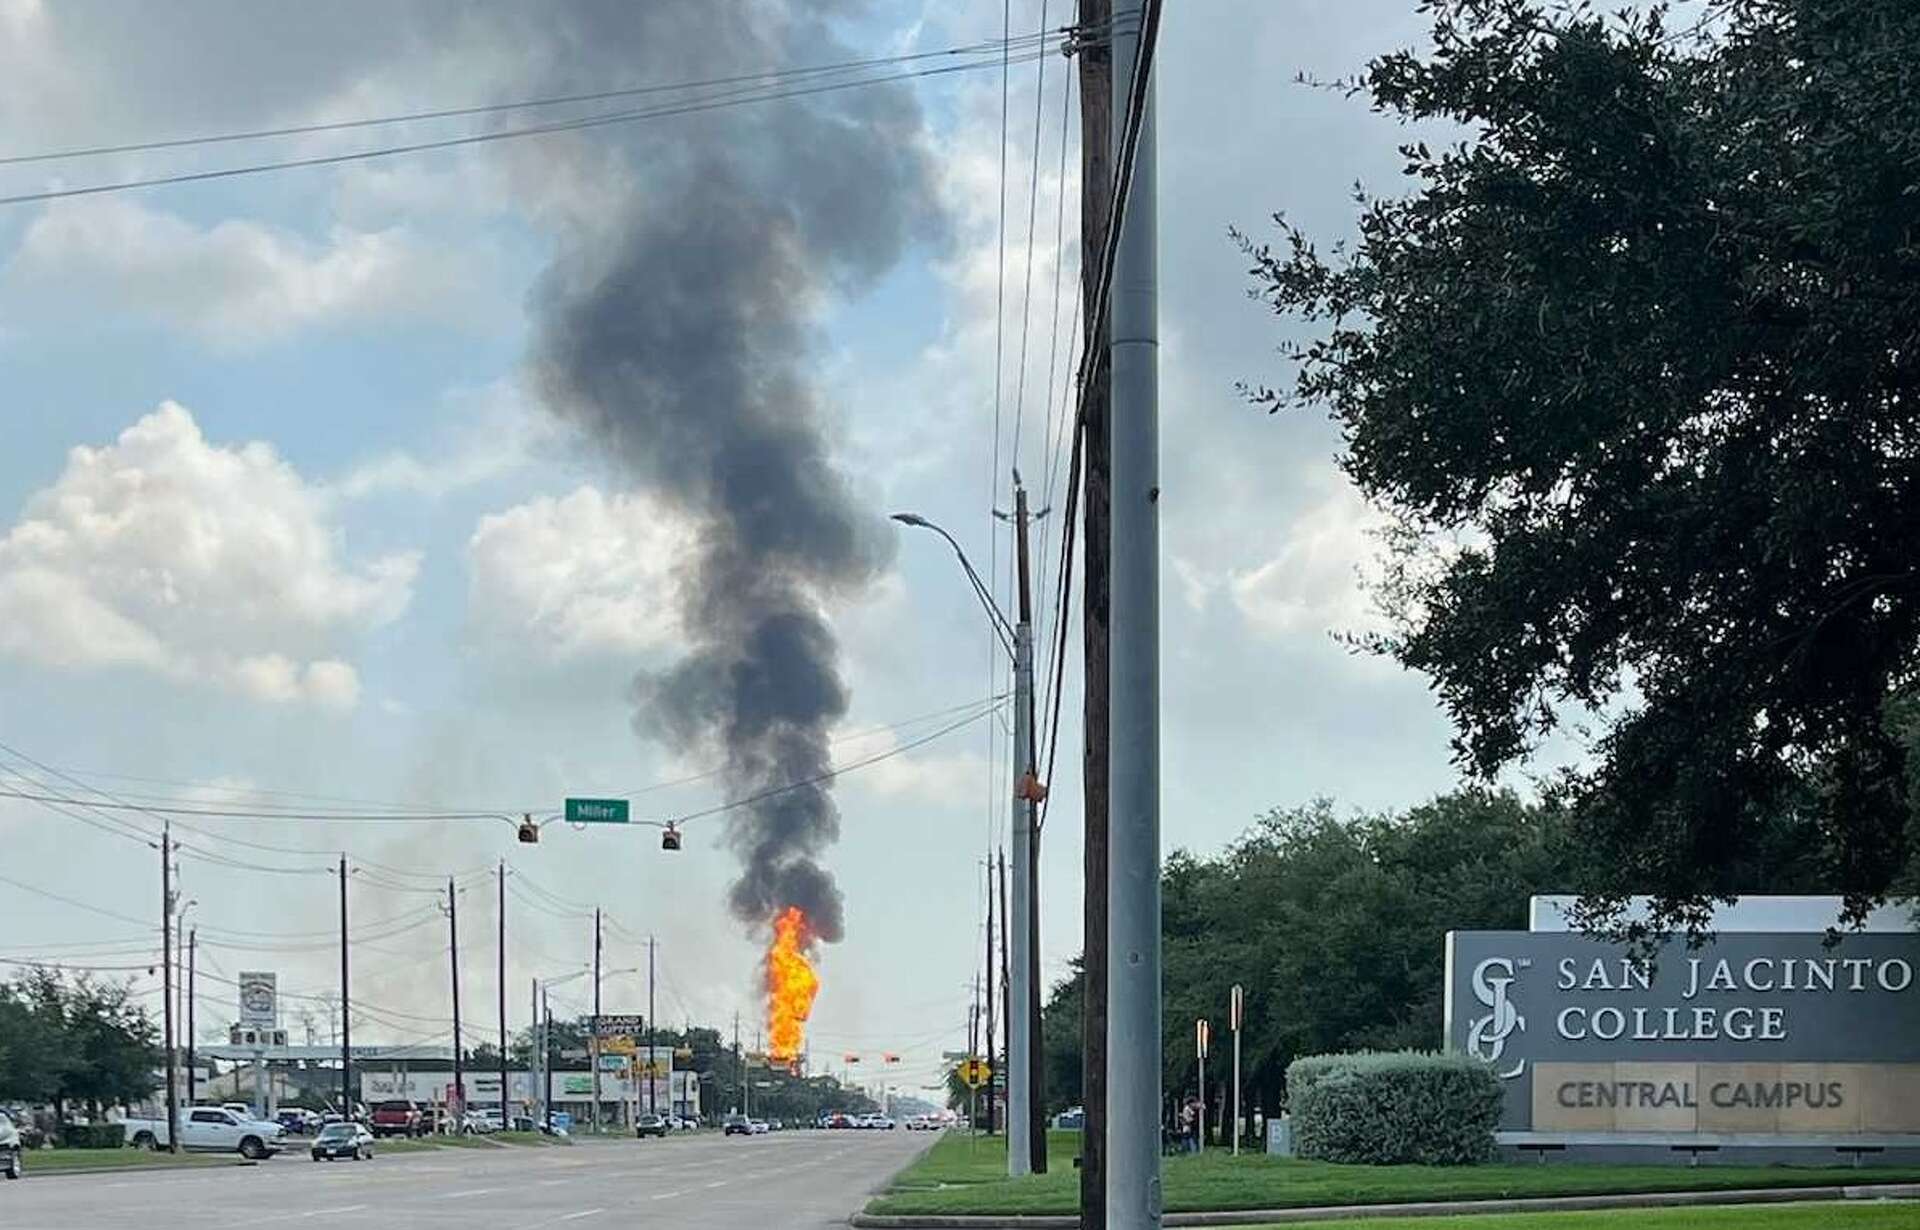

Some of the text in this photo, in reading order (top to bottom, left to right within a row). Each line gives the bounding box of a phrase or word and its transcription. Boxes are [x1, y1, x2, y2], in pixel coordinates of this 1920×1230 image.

[577, 804, 616, 818] Miller
[1557, 957, 1913, 999] SAN JACINTO
[1557, 1006, 1788, 1041] COLLEGE
[1556, 1081, 1844, 1109] CENTRAL CAMPUS
